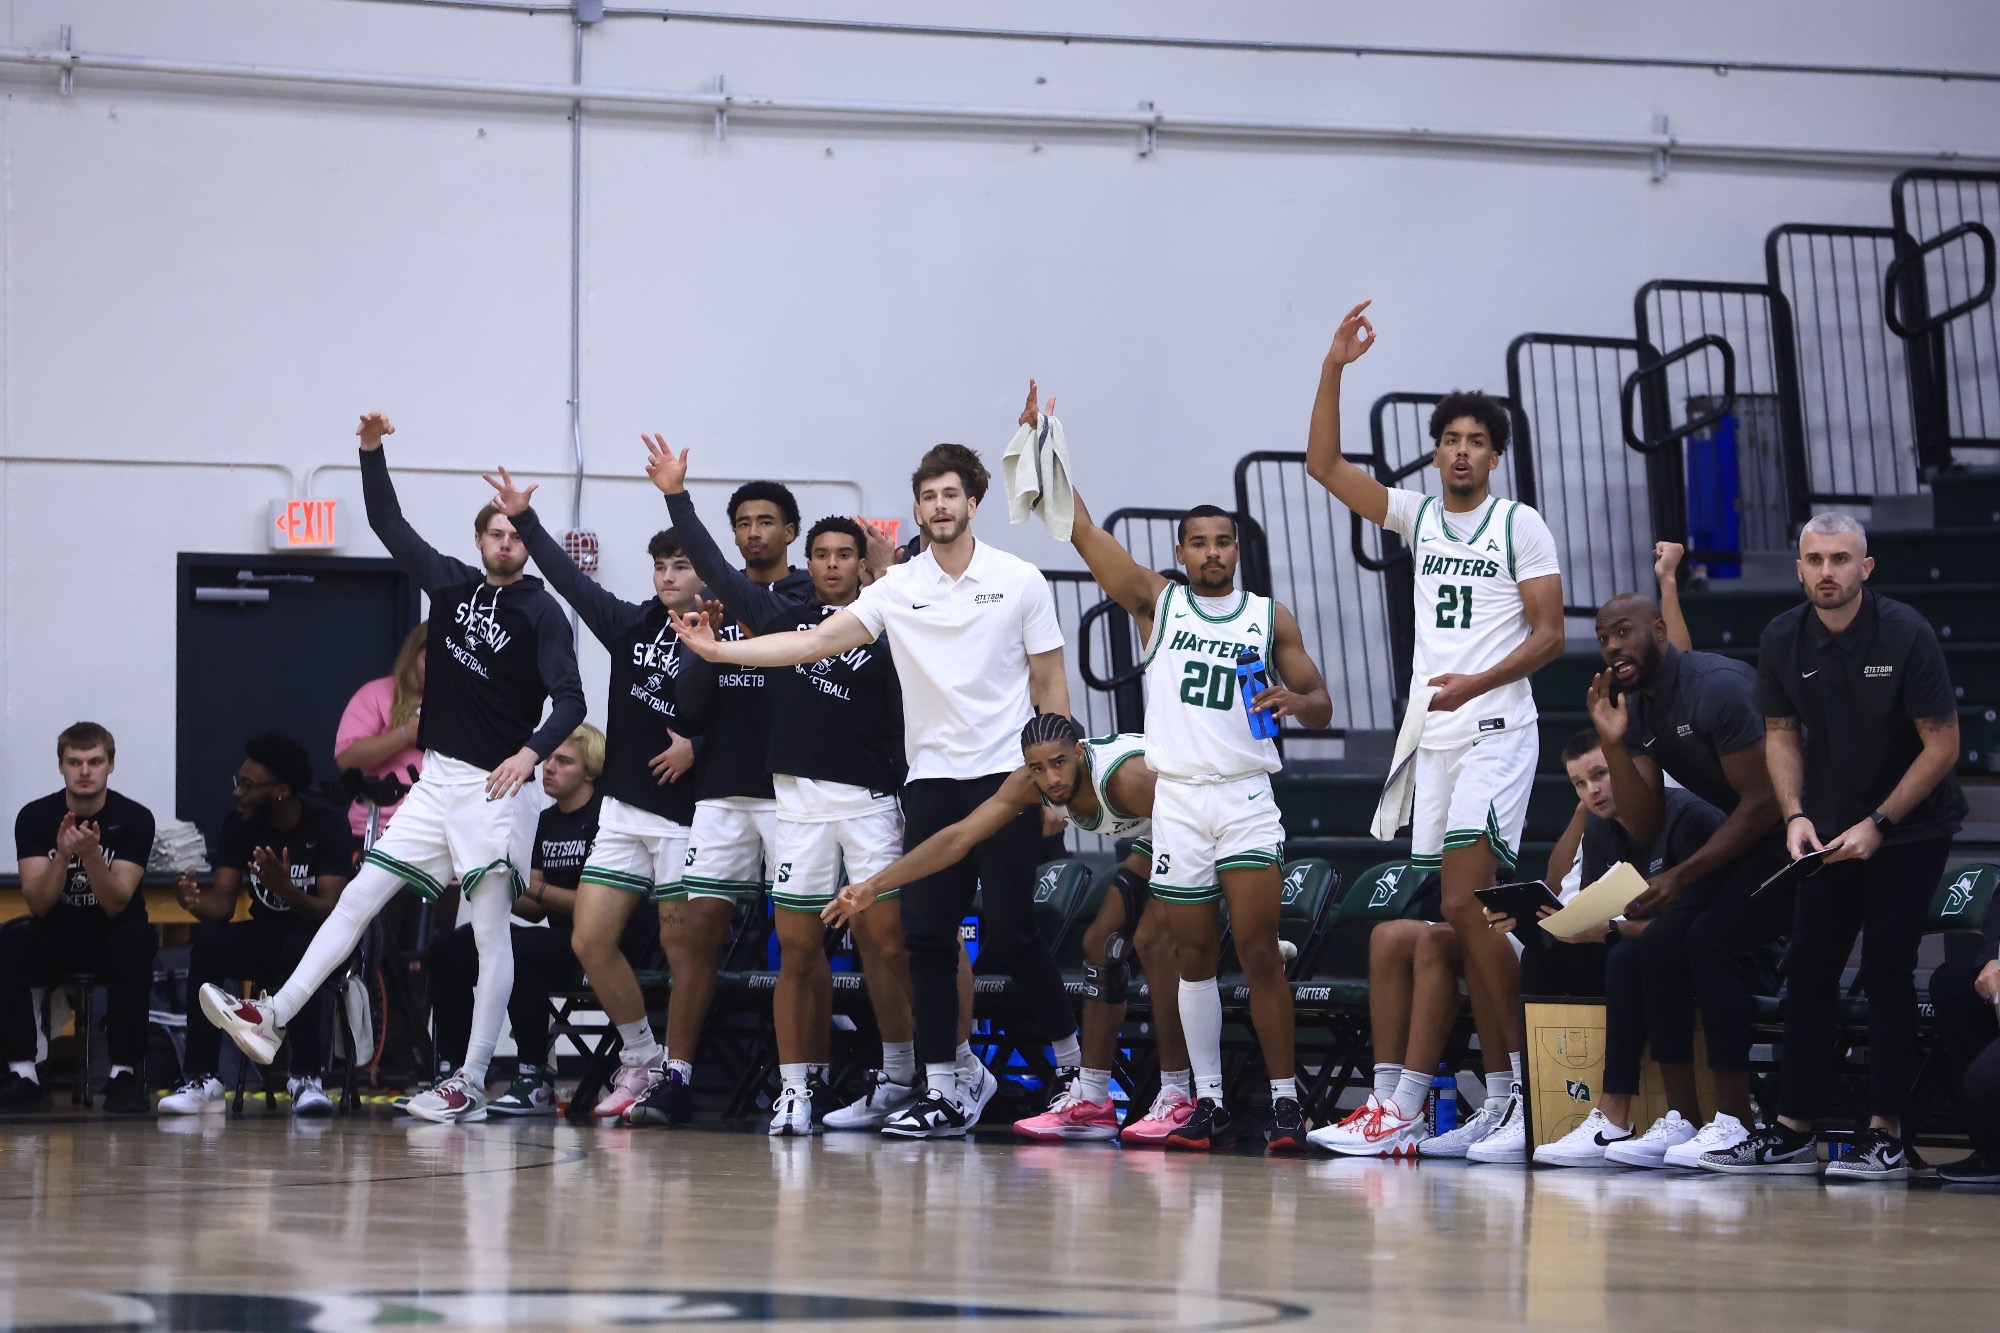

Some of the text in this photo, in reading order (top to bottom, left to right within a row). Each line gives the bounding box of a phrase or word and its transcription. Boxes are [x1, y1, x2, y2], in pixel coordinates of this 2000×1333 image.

[287, 500, 337, 545] EXIT
[1421, 554, 1500, 578] HATTERS
[1435, 584, 1473, 629] 21
[1863, 665, 1893, 674] STETSON
[719, 674, 765, 687] BASKETB
[1180, 660, 1237, 712] 20
[541, 840, 587, 858] STETSON
[1296, 986, 1332, 1001] HATTERS
